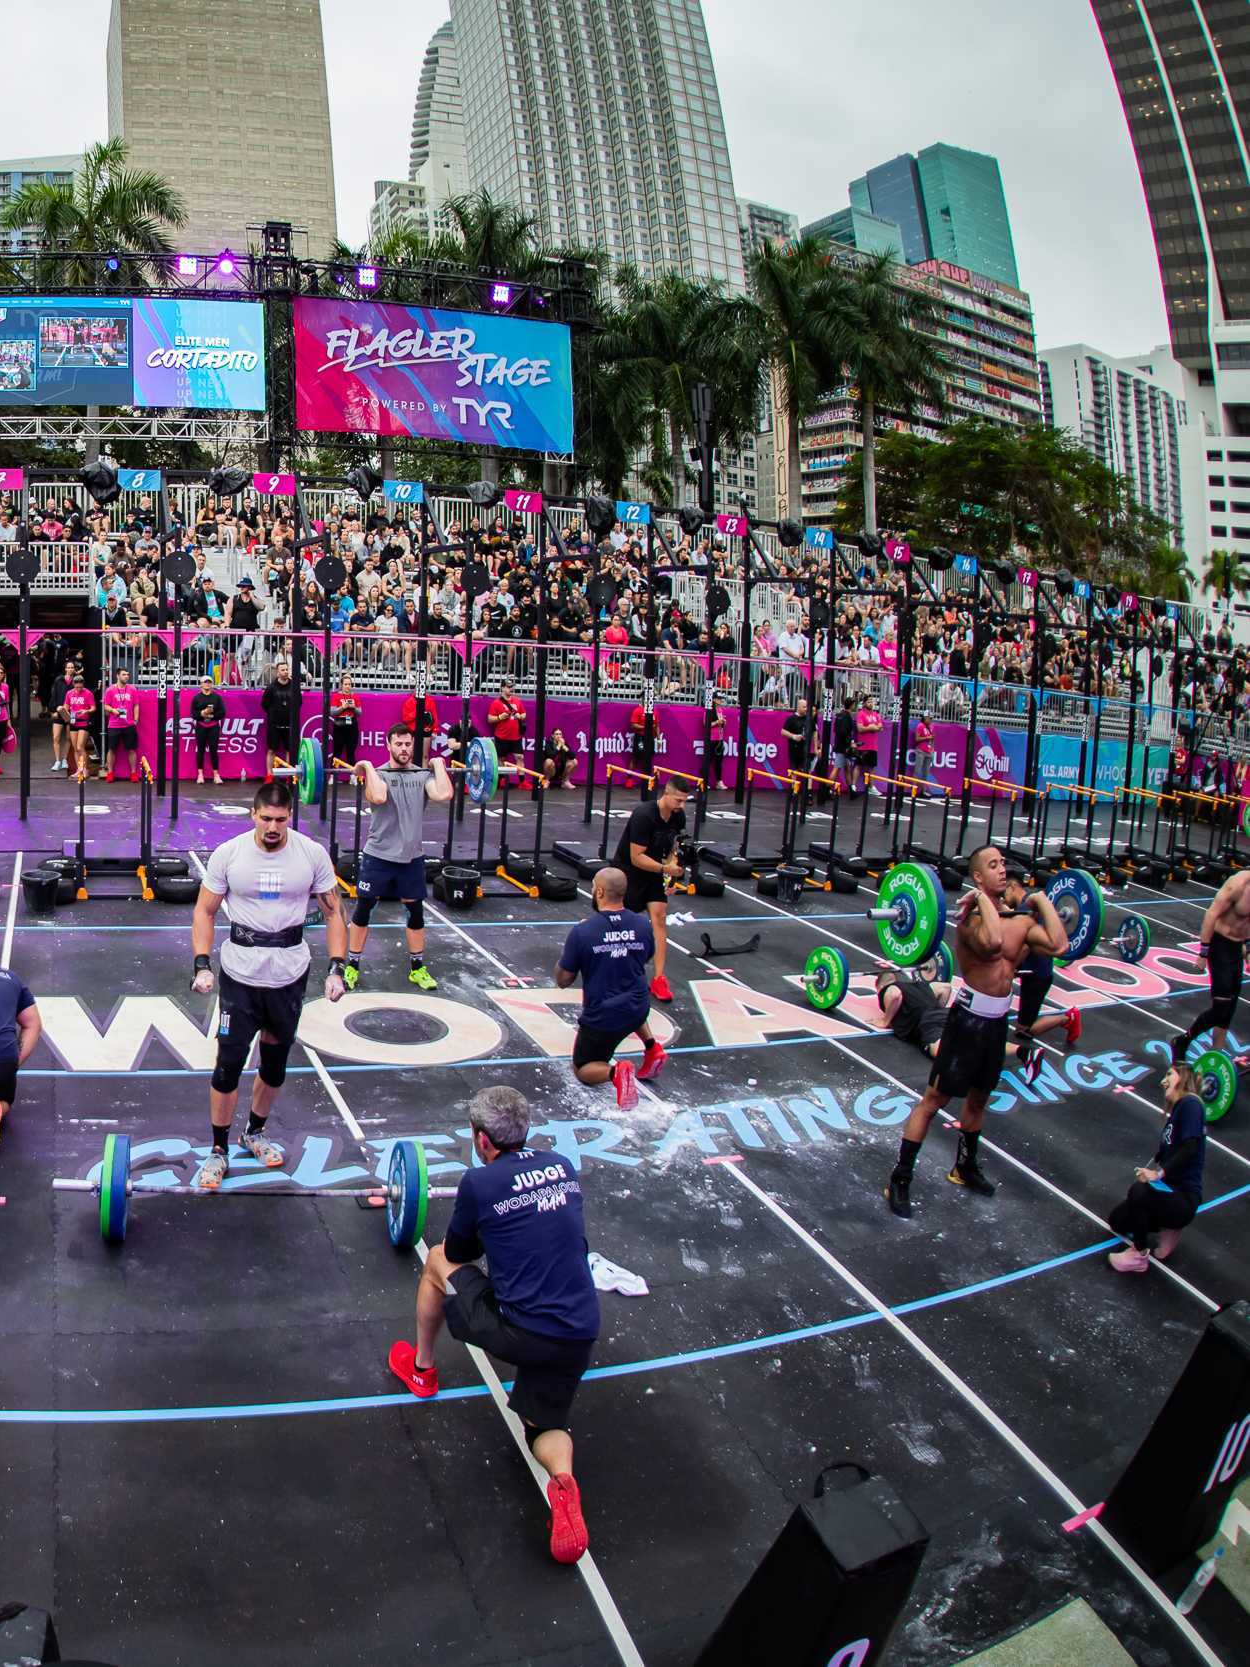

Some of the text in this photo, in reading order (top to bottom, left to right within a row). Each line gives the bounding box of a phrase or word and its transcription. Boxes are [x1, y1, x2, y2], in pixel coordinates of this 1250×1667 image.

[175, 336, 230, 348] ELITE MEN
[325, 326, 477, 362] FLAGLER
[146, 348, 258, 372] CORTADITO
[455, 356, 552, 388] STAGE
[361, 397, 448, 413] POWERED BY
[451, 396, 514, 430] TYR
[132, 472, 146, 488] 8
[267, 475, 279, 492] 9
[395, 483, 412, 500] 10
[515, 494, 532, 510] 11
[626, 505, 641, 520] 12
[725, 518, 738, 533] 13
[813, 531, 826, 545] 14
[893, 546, 905, 559] 15
[961, 558, 971, 571] 16
[1021, 571, 1031, 583] 17
[159, 659, 167, 699] ROGUE
[419, 661, 427, 699] ROGUE
[165, 717, 264, 736] ASULT
[166, 735, 258, 754] FTESS
[575, 732, 625, 759] Lquid
[1056, 766, 1081, 779] ARMY
[453, 890, 463, 898] R
[889, 872, 926, 902] ROGUE
[1048, 877, 1076, 904] OGUE
[603, 930, 636, 943] JUDGE
[882, 927, 920, 956] ROGUE
[1069, 914, 1091, 952] ROG
[34, 941, 1220, 1073] WODAPLOO
[86, 1049, 1154, 1190] CELERATING SINCE
[511, 1163, 567, 1192] JUDGE
[537, 1192, 567, 1213] MIAMI
